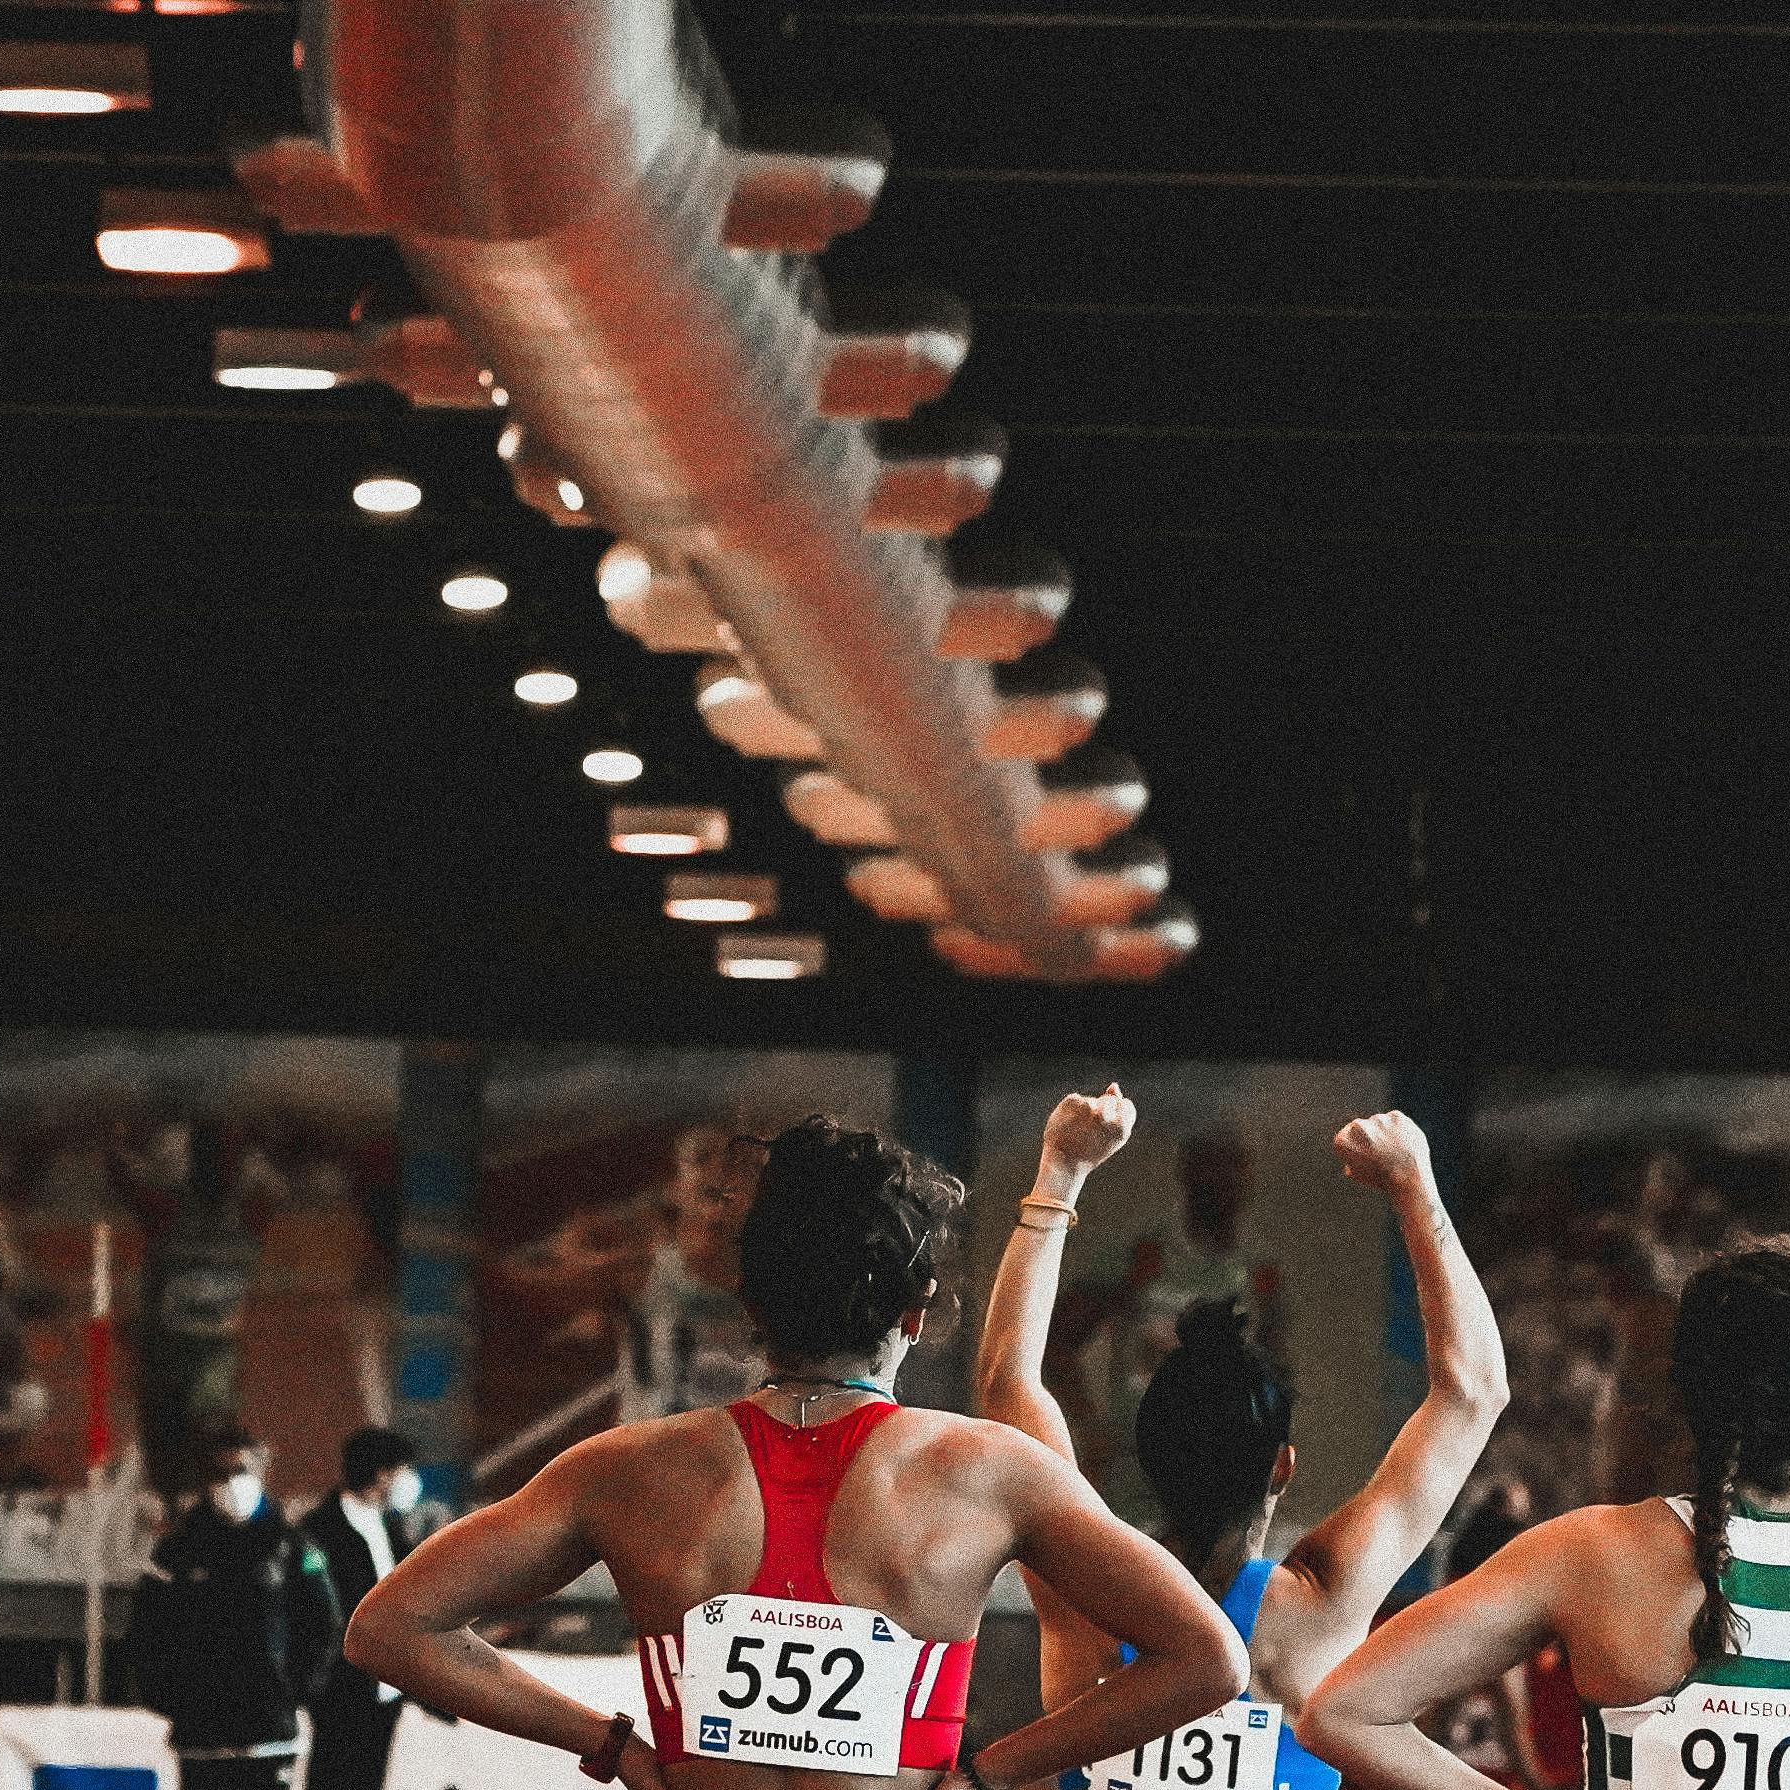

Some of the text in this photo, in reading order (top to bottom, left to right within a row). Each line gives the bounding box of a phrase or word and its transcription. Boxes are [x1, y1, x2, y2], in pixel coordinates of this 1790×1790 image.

[750, 1608, 843, 1631] AALISBOA
[717, 1635, 865, 1722] 552
[738, 1727, 873, 1759] zumub.com
